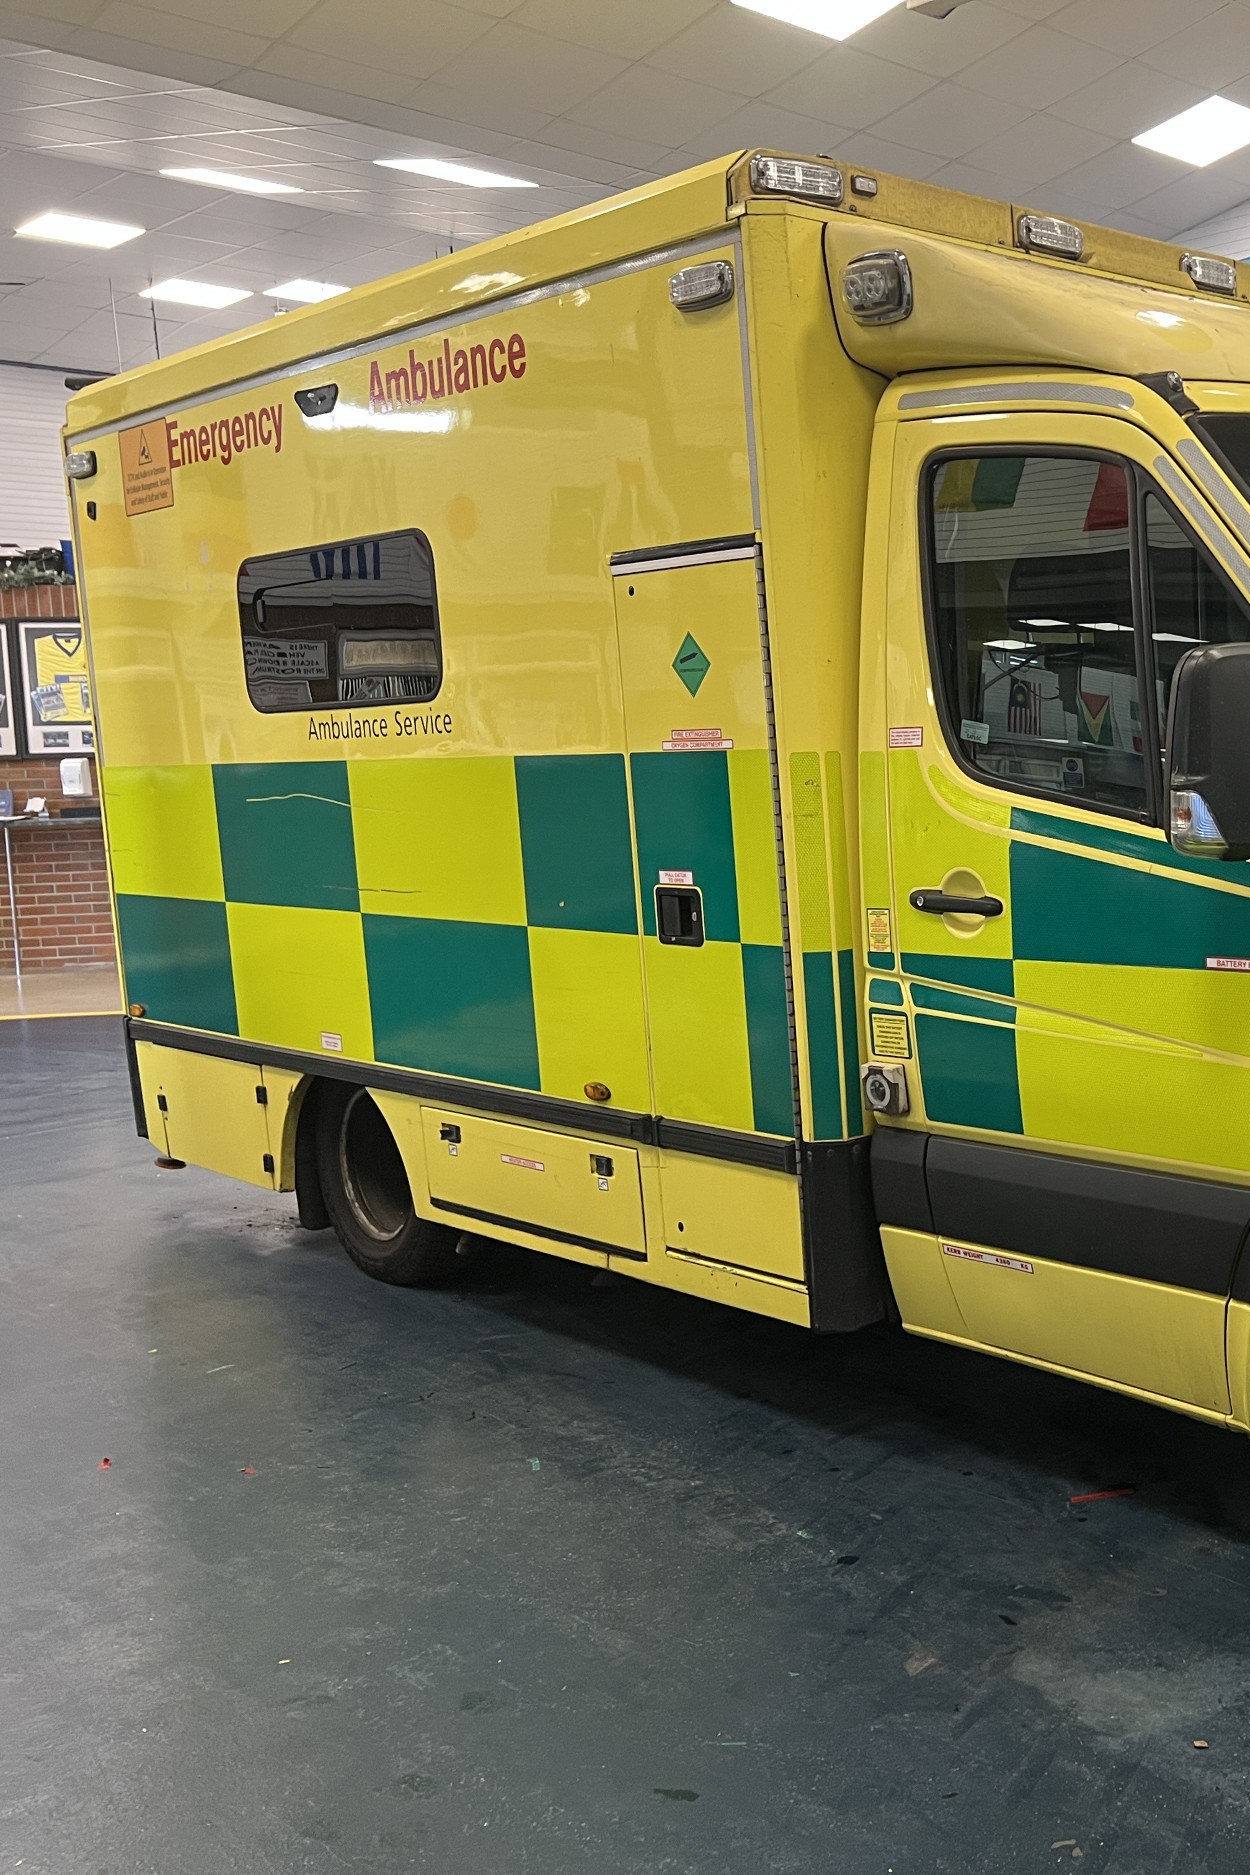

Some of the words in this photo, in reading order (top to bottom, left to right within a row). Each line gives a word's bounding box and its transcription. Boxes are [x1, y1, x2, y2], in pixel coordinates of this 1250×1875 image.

[166, 403, 282, 470] Emergency
[368, 333, 528, 416] Ambulance
[308, 712, 388, 741] Ambulance
[394, 707, 452, 737] Service
[1216, 960, 1247, 968] BATTERY
[963, 1250, 984, 1260] WEIGHT
